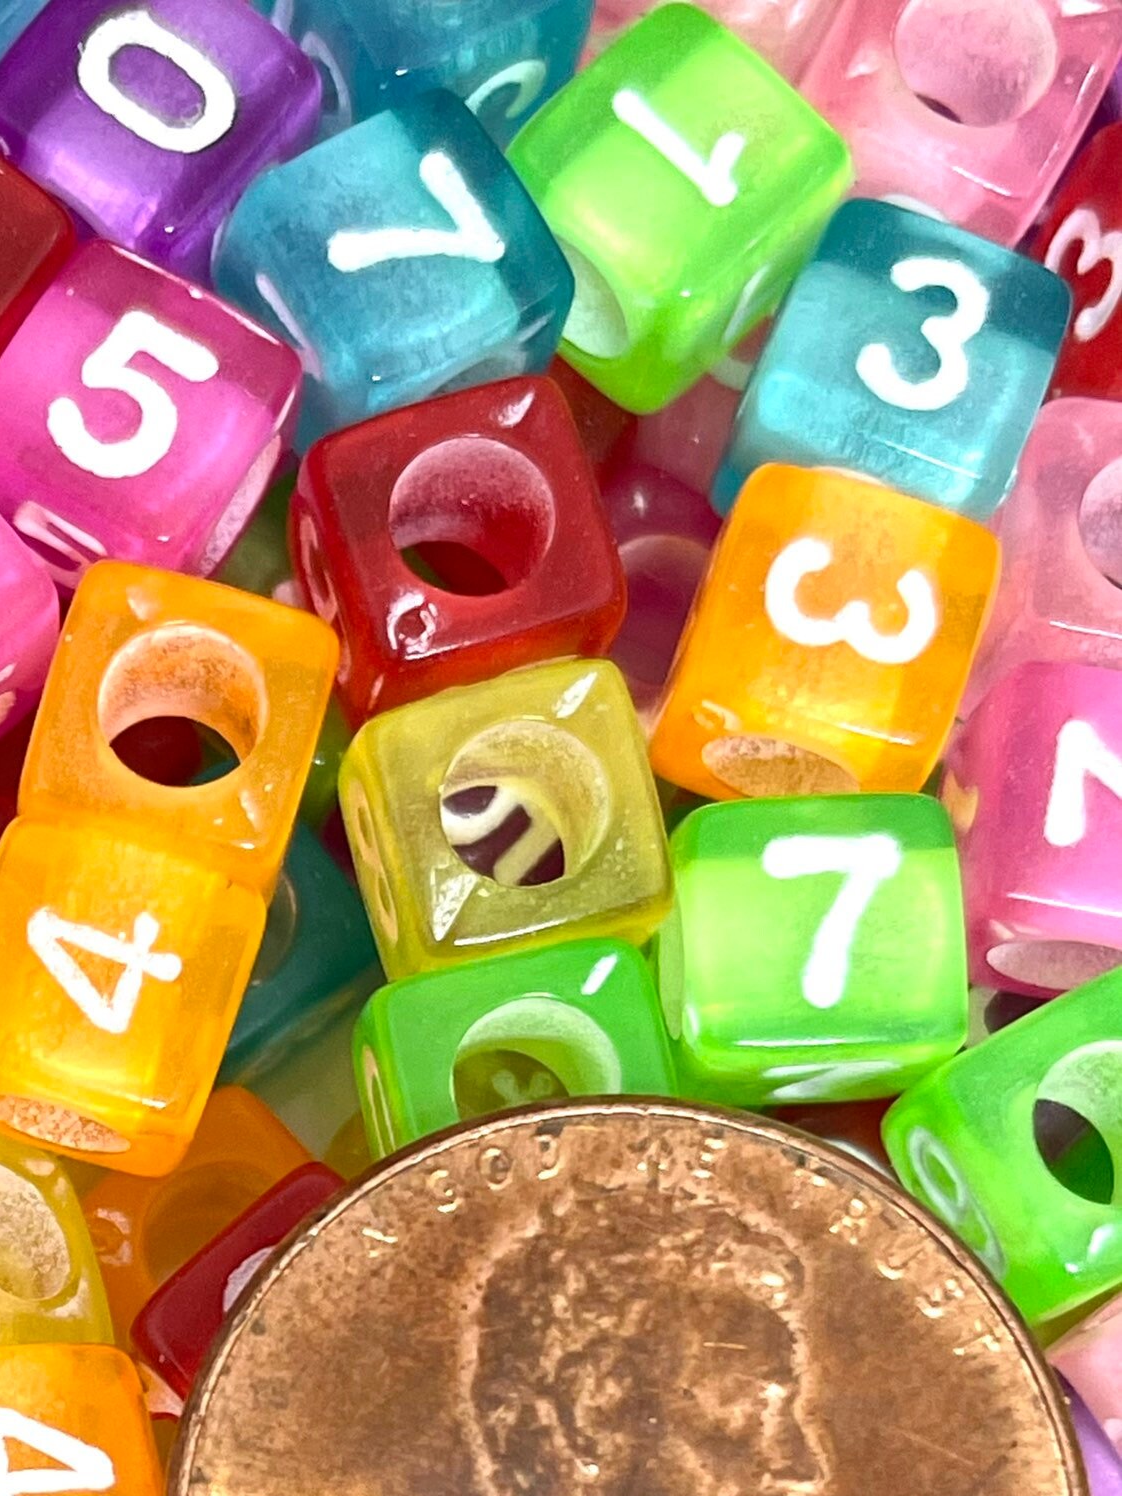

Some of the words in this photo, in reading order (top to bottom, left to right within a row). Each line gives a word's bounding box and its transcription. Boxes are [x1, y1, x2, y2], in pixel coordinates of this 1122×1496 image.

[78, 10, 235, 152] 0
[48, 311, 218, 478] 5
[856, 257, 989, 410] 3
[766, 535, 938, 663] 3
[27, 907, 182, 1034] 4
[762, 834, 903, 1008] 7
